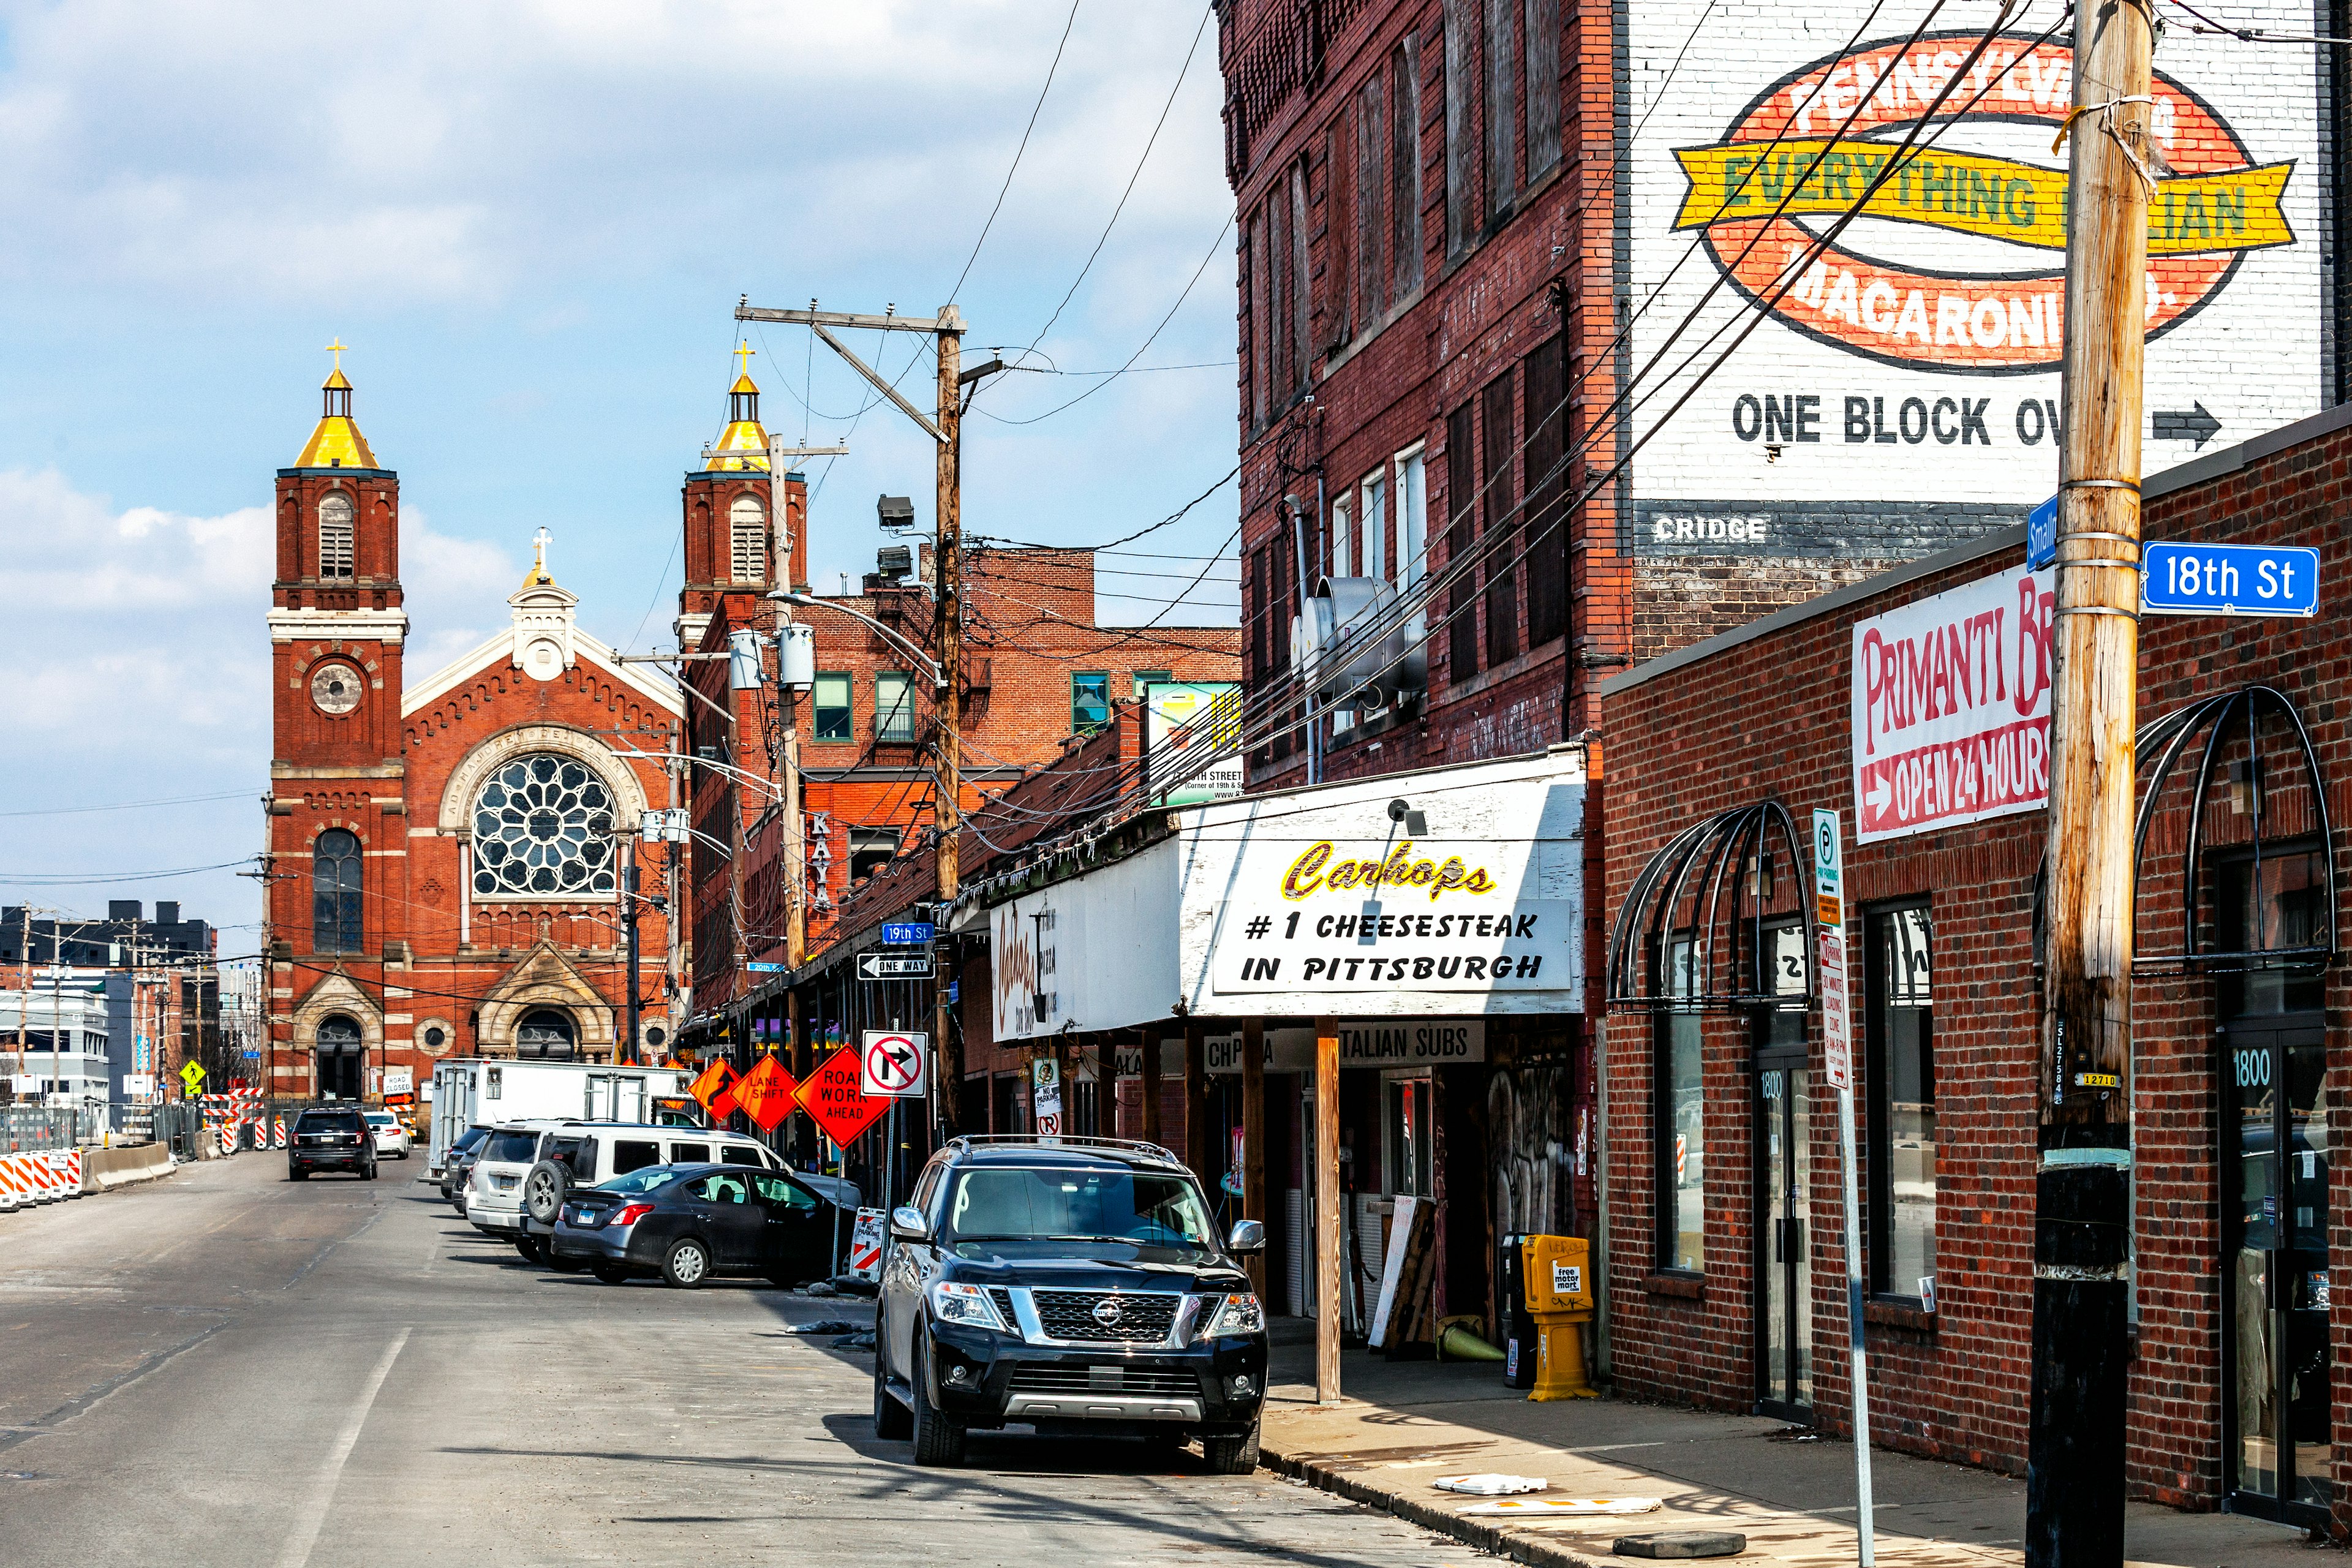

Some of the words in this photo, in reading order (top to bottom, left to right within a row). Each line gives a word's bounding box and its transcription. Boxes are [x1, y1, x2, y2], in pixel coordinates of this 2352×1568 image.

[1724, 154, 2035, 228] EVERYTHING
[1784, 248, 2060, 348] MACARONI
[1733, 394, 1821, 442] ONE
[1845, 397, 1991, 445] BLOCK
[1654, 518, 1766, 543] CRIDGE
[2167, 556, 2239, 597] 18th
[2256, 559, 2294, 599] St
[1862, 606, 2007, 756] PRIMANTI
[1210, 771, 1242, 780] STREET
[1895, 750, 1950, 822] OPEN
[1952, 746, 1977, 810] 24
[812, 811, 832, 910] KAYA
[1281, 840, 1497, 902] Carhops
[1824, 867, 1838, 881] PARKING
[889, 928, 911, 940] 19th
[916, 929, 927, 939] St
[1245, 916, 1272, 940] #
[1285, 911, 1301, 939] 1
[1316, 914, 1538, 939] CHEESESTEAK
[1821, 940, 1828, 962] NO
[1828, 946, 1841, 962] PARKING
[880, 960, 899, 971] ONE
[903, 960, 925, 970] WAY
[1240, 957, 1281, 981] IN
[1303, 955, 1542, 981] PITTSBURGH
[1823, 974, 1829, 989] 30
[1829, 977, 1842, 993] MINUTE
[1826, 995, 1842, 1013] LOADING
[1830, 1017, 1840, 1033] ZONE
[1340, 1029, 1407, 1057] TALIAN
[1415, 1027, 1468, 1057] SUBS
[2233, 1048, 2271, 1087] 1800
[386, 1084, 410, 1092] CLOSED
[750, 1078, 779, 1087] LANE
[1761, 1071, 1782, 1099] 1800
[2085, 1076, 2115, 1085] 12710
[753, 1089, 783, 1099] SHIFT
[821, 1087, 867, 1103] WORK
[1037, 1093, 1058, 1104] PARKING
[826, 1106, 862, 1120] AHEAD
[858, 1229, 880, 1237] PARKING
